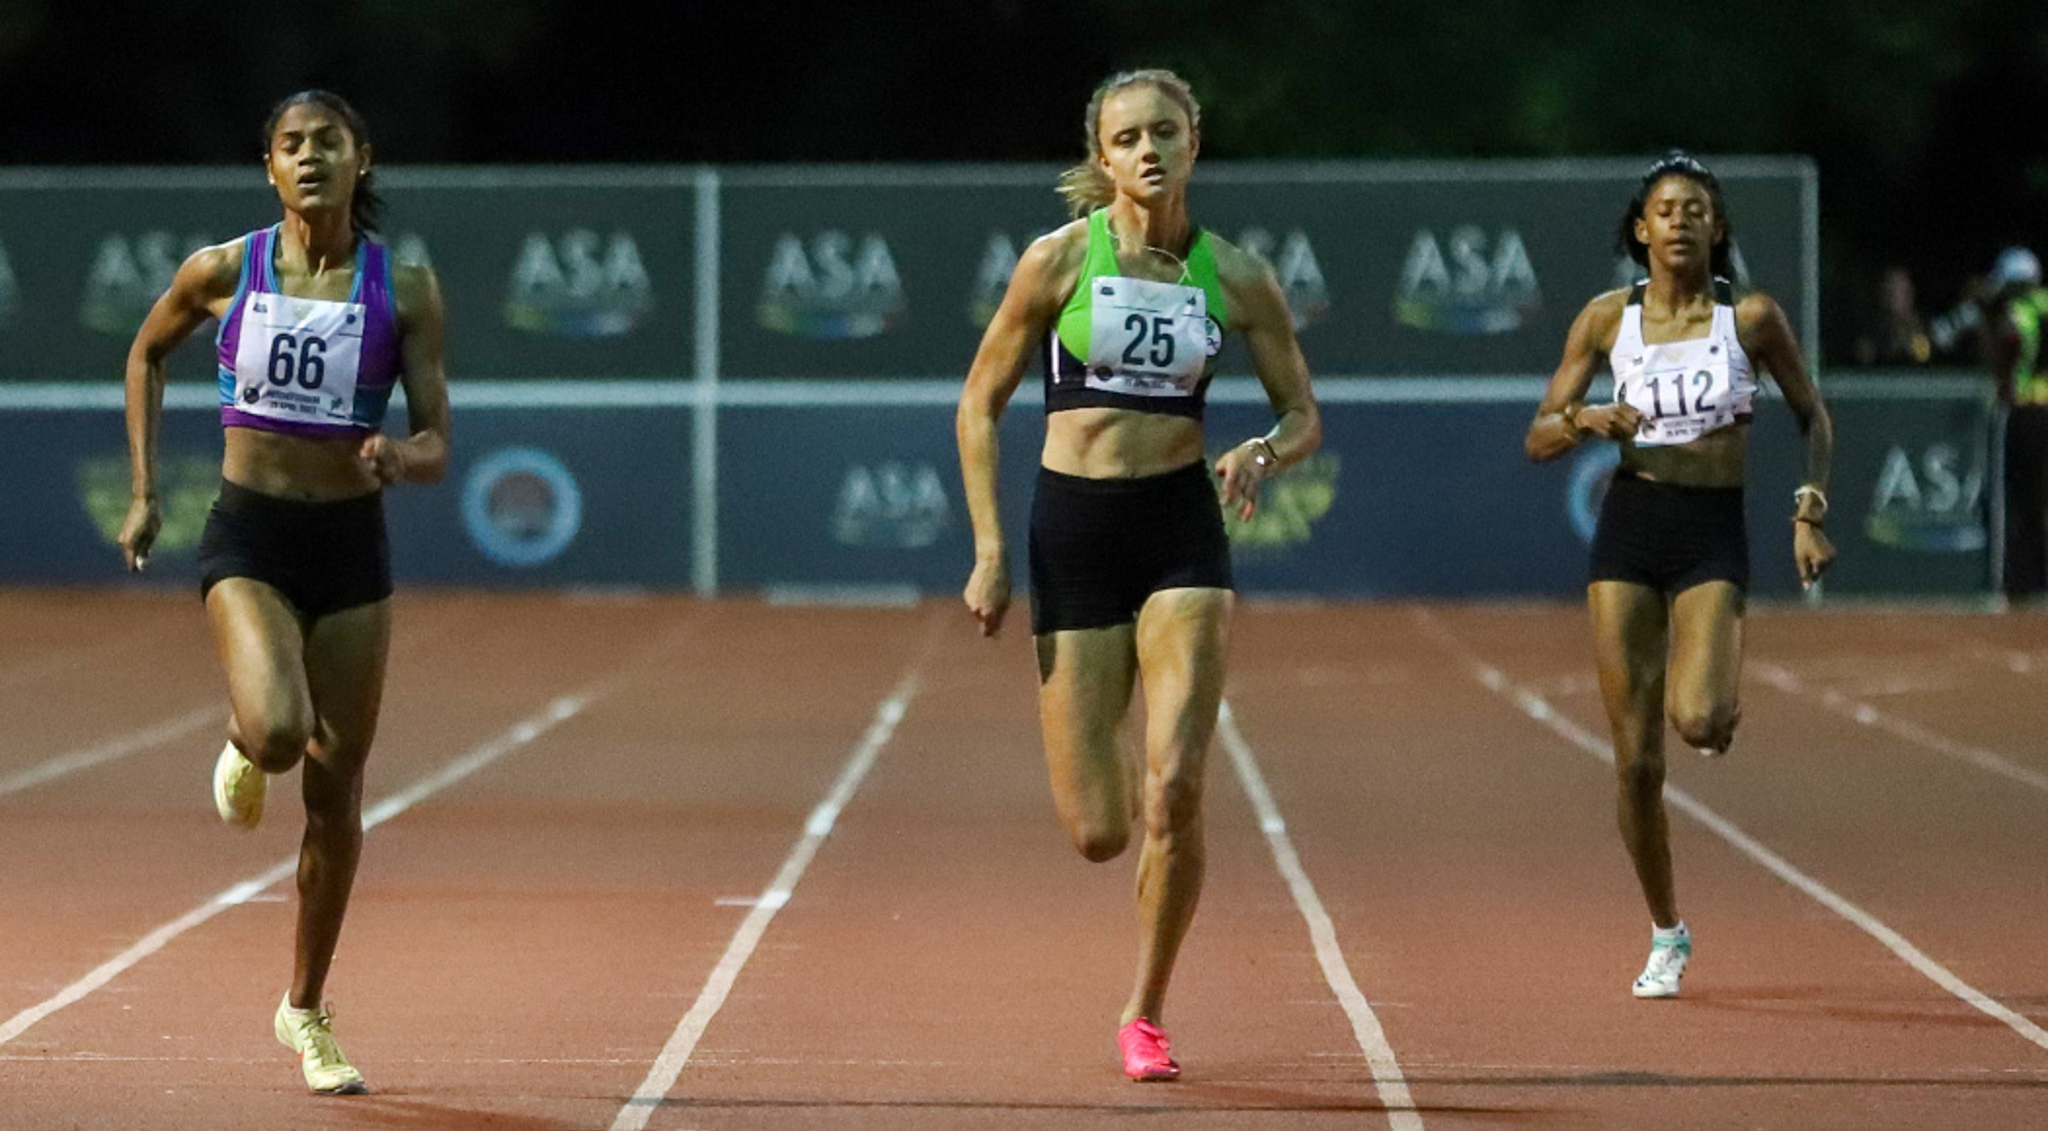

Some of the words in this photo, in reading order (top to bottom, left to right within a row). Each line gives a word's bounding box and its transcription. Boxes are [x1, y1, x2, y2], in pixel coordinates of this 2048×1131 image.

[510, 230, 649, 300] ASA
[765, 232, 899, 300] ASA
[1401, 228, 1539, 299] ASA
[268, 333, 327, 389] 66
[1122, 314, 1175, 367] 25
[1646, 370, 1715, 418] 112
